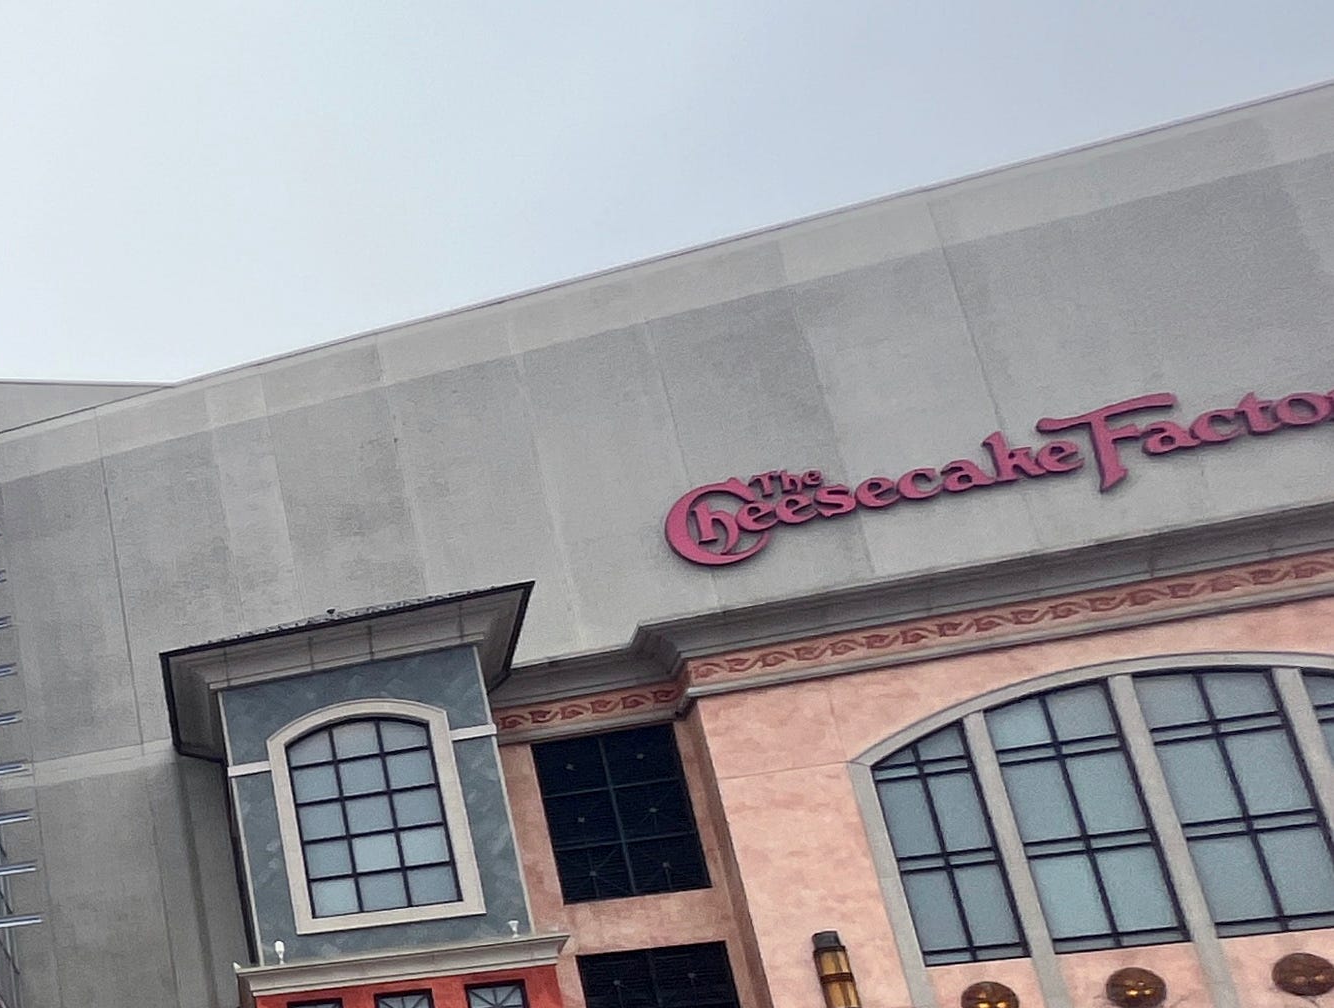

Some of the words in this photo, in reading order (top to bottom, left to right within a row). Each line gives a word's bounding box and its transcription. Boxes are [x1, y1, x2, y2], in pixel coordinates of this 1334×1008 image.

[665, 431, 1084, 566] Cheesecake
[1036, 392, 1334, 493] Facto
[751, 468, 822, 497] The
